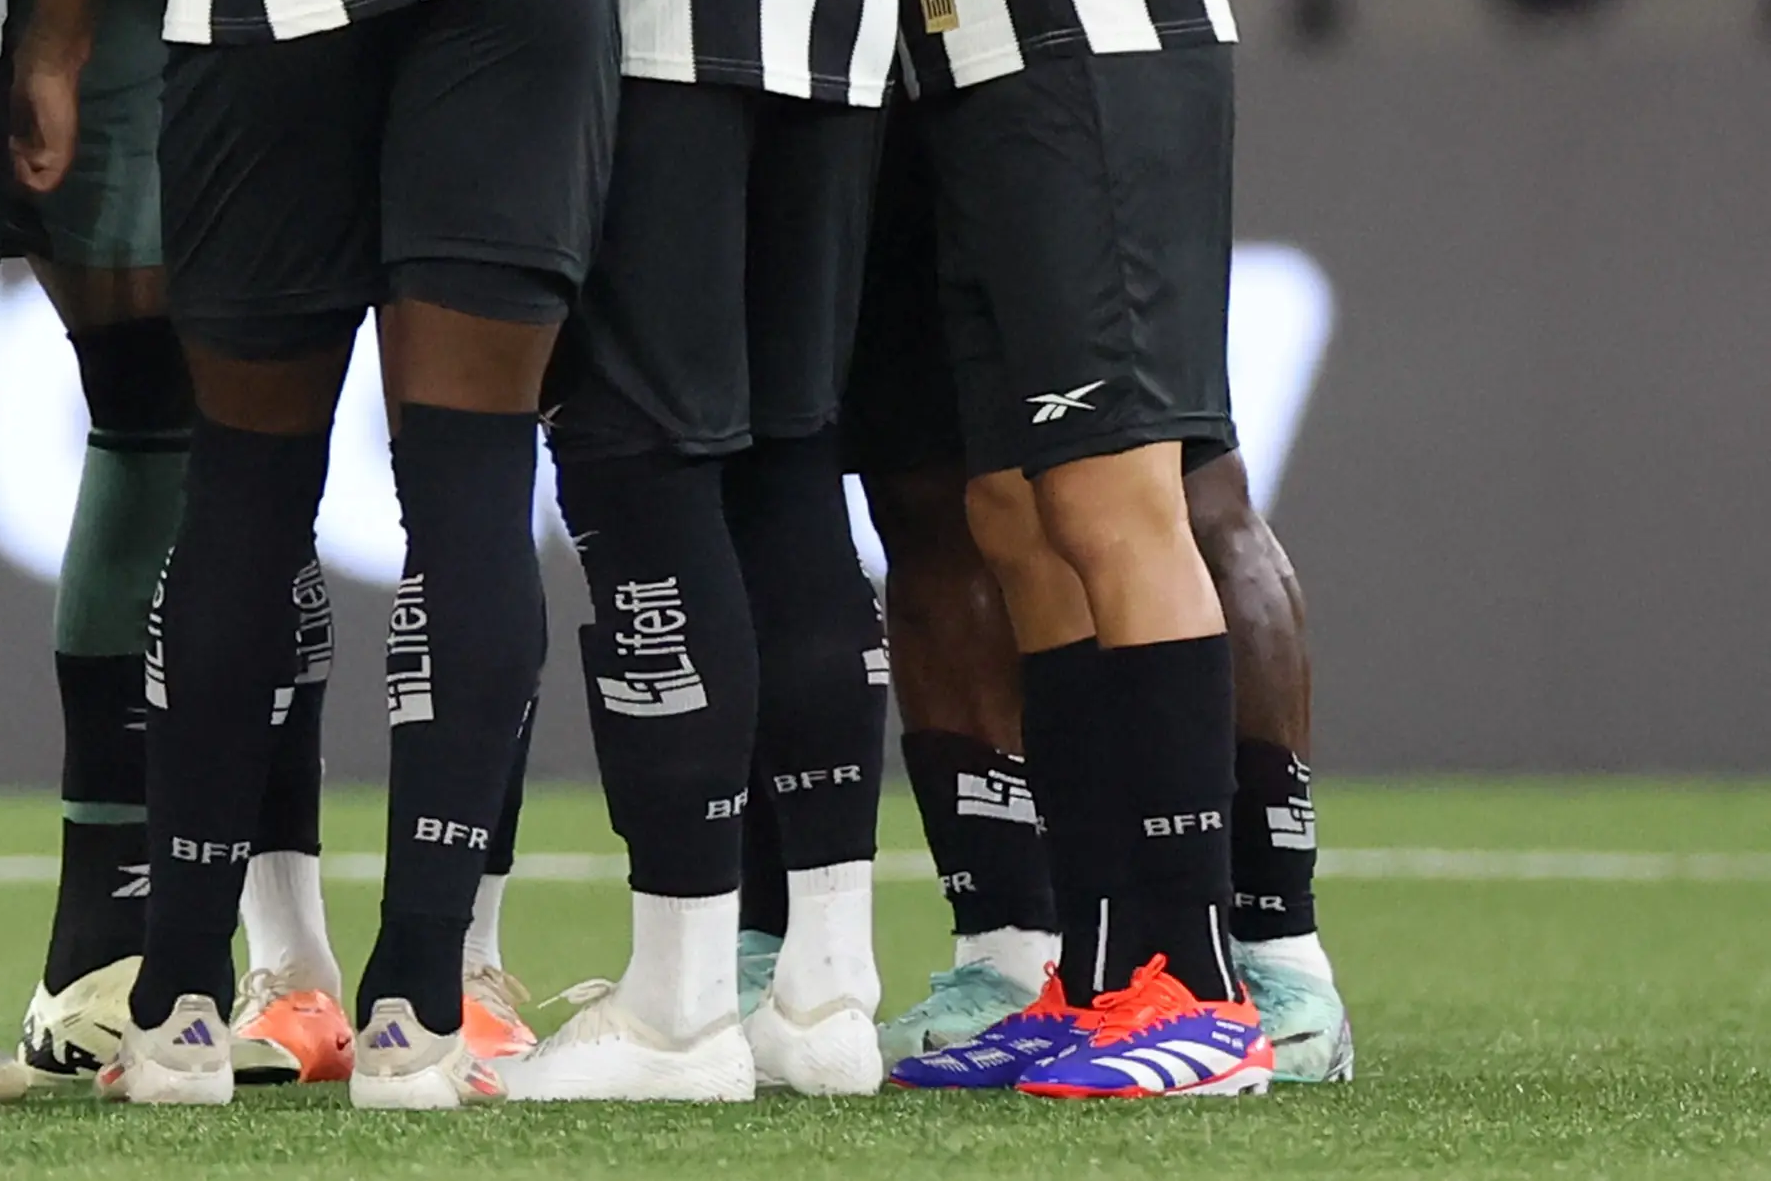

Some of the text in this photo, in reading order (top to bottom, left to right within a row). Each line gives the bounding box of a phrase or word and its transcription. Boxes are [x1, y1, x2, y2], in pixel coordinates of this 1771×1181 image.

[614, 576, 697, 680] Lifefit
[773, 764, 863, 794] BFR
[413, 816, 489, 851] BFR
[1143, 810, 1224, 838] BFR
[171, 836, 252, 863] BFR
